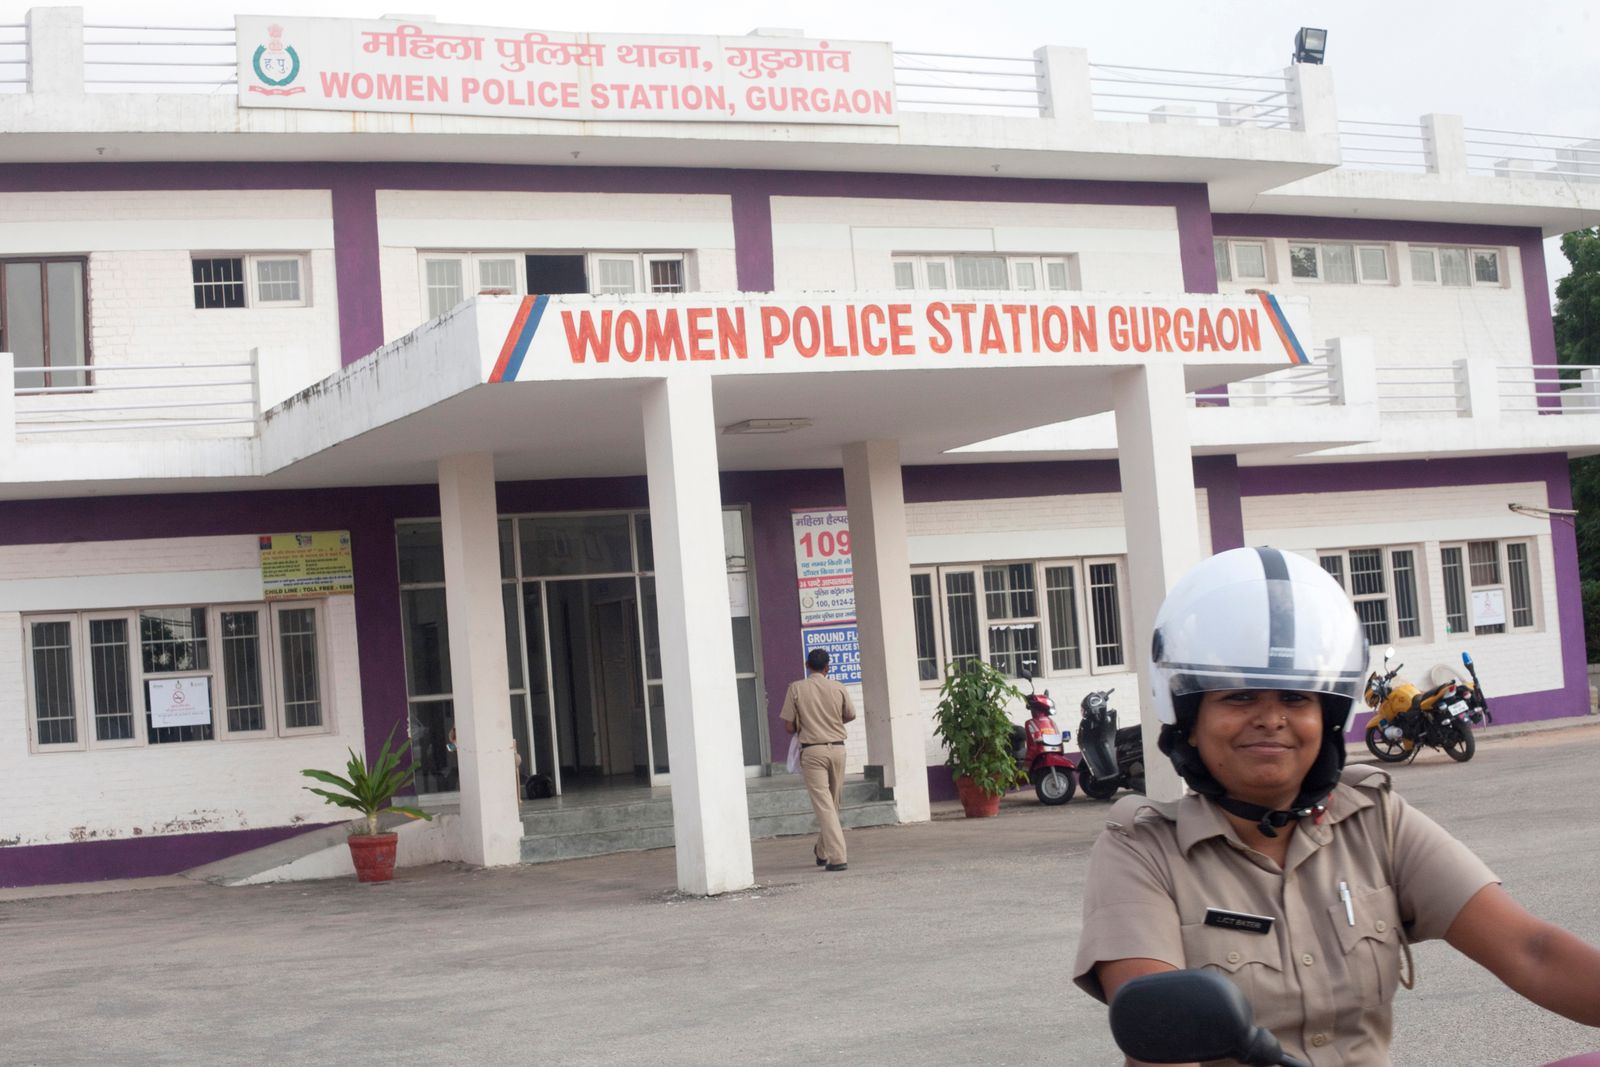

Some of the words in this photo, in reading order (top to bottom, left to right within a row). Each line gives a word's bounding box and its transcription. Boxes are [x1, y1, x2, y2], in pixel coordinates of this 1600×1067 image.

[361, 25, 484, 60] महिला
[495, 32, 606, 72] पुलिस
[617, 44, 712, 72] थाना,
[725, 41, 851, 79] गुड़गांव
[320, 72, 448, 102] WOMEN
[462, 78, 579, 108] POLICE
[591, 84, 736, 116] STATION,
[746, 86, 892, 115] GURGAON
[560, 306, 748, 363] WOMEN
[760, 304, 916, 358] POLICE
[925, 302, 1098, 354] STATION
[1108, 305, 1262, 353] GURGAON
[795, 514, 823, 526] महिला
[800, 530, 852, 557] 109
[808, 632, 845, 643] GROUND
[847, 631, 858, 641] FL
[831, 643, 852, 652] POLICE
